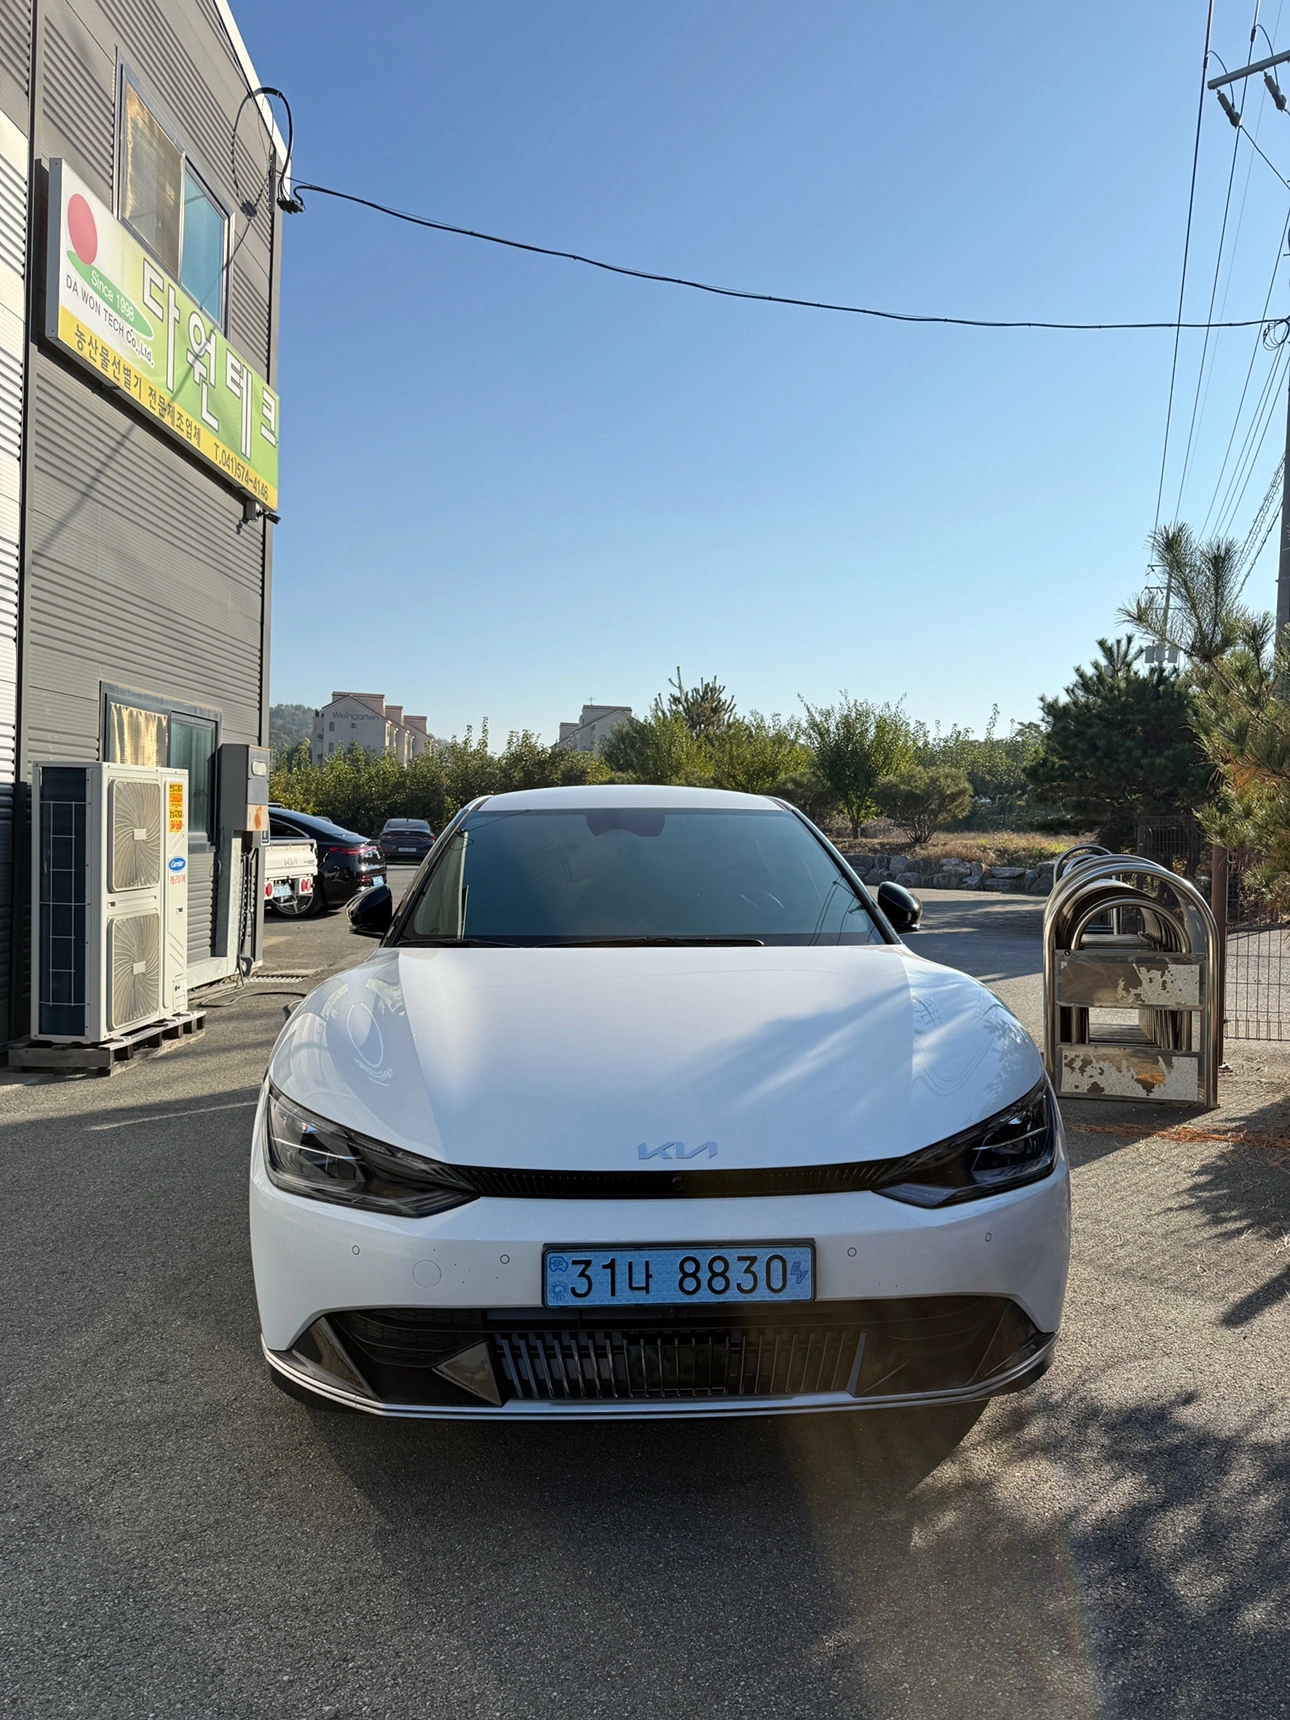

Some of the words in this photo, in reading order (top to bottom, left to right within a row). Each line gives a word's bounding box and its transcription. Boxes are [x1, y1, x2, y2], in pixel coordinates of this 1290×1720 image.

[66, 274, 79, 297] DA
[81, 287, 101, 317] WON
[103, 308, 124, 338] TECH
[91, 269, 114, 302] Since
[116, 294, 135, 322] 1998
[75, 323, 142, 400] 농산물선별기
[148, 386, 201, 448] 전문제조업체
[143, 257, 277, 461] 다원테크
[332, 711, 379, 722] Weingarten
[637, 1141, 718, 1160] KIA
[570, 1258, 653, 1299] 31나
[677, 1254, 788, 1296] 8830
